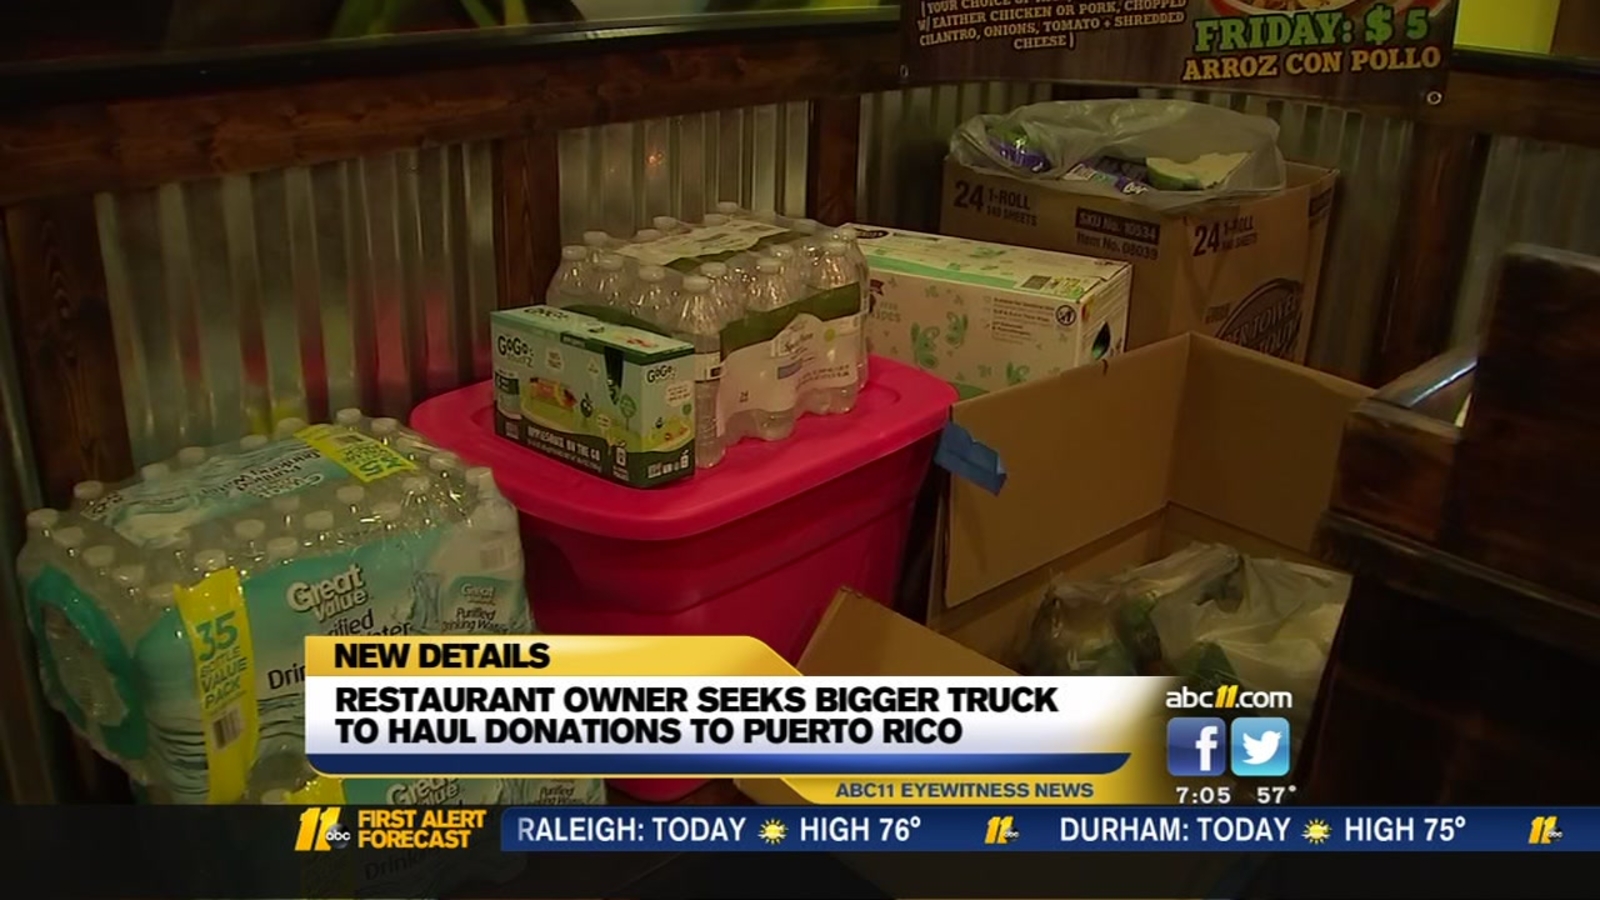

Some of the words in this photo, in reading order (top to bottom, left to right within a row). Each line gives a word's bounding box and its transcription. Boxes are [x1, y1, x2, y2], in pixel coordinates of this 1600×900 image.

[920, 27, 981, 46] CILANTRO,
[983, 21, 1040, 37] ONIONS,
[1042, 17, 1100, 33] TOMATO
[1114, 10, 1185, 27] SHREDDED
[989, 6, 1053, 21] CHICKEN
[1055, 4, 1076, 17] OR
[1079, 1, 1120, 15] PORK,
[1124, 0, 1187, 11] CHOPPED
[1194, 12, 1352, 52] FRIDAY:
[1182, 55, 1279, 82] ARROZ
[1285, 50, 1343, 76] CON
[1350, 45, 1442, 72] POLLO
[954, 179, 985, 213] 24
[1192, 221, 1220, 257] 24
[286, 563, 366, 613] Great
[313, 587, 369, 624] Value
[196, 610, 238, 661] 35
[202, 656, 248, 693] VALUE
[205, 676, 242, 709] PACK
